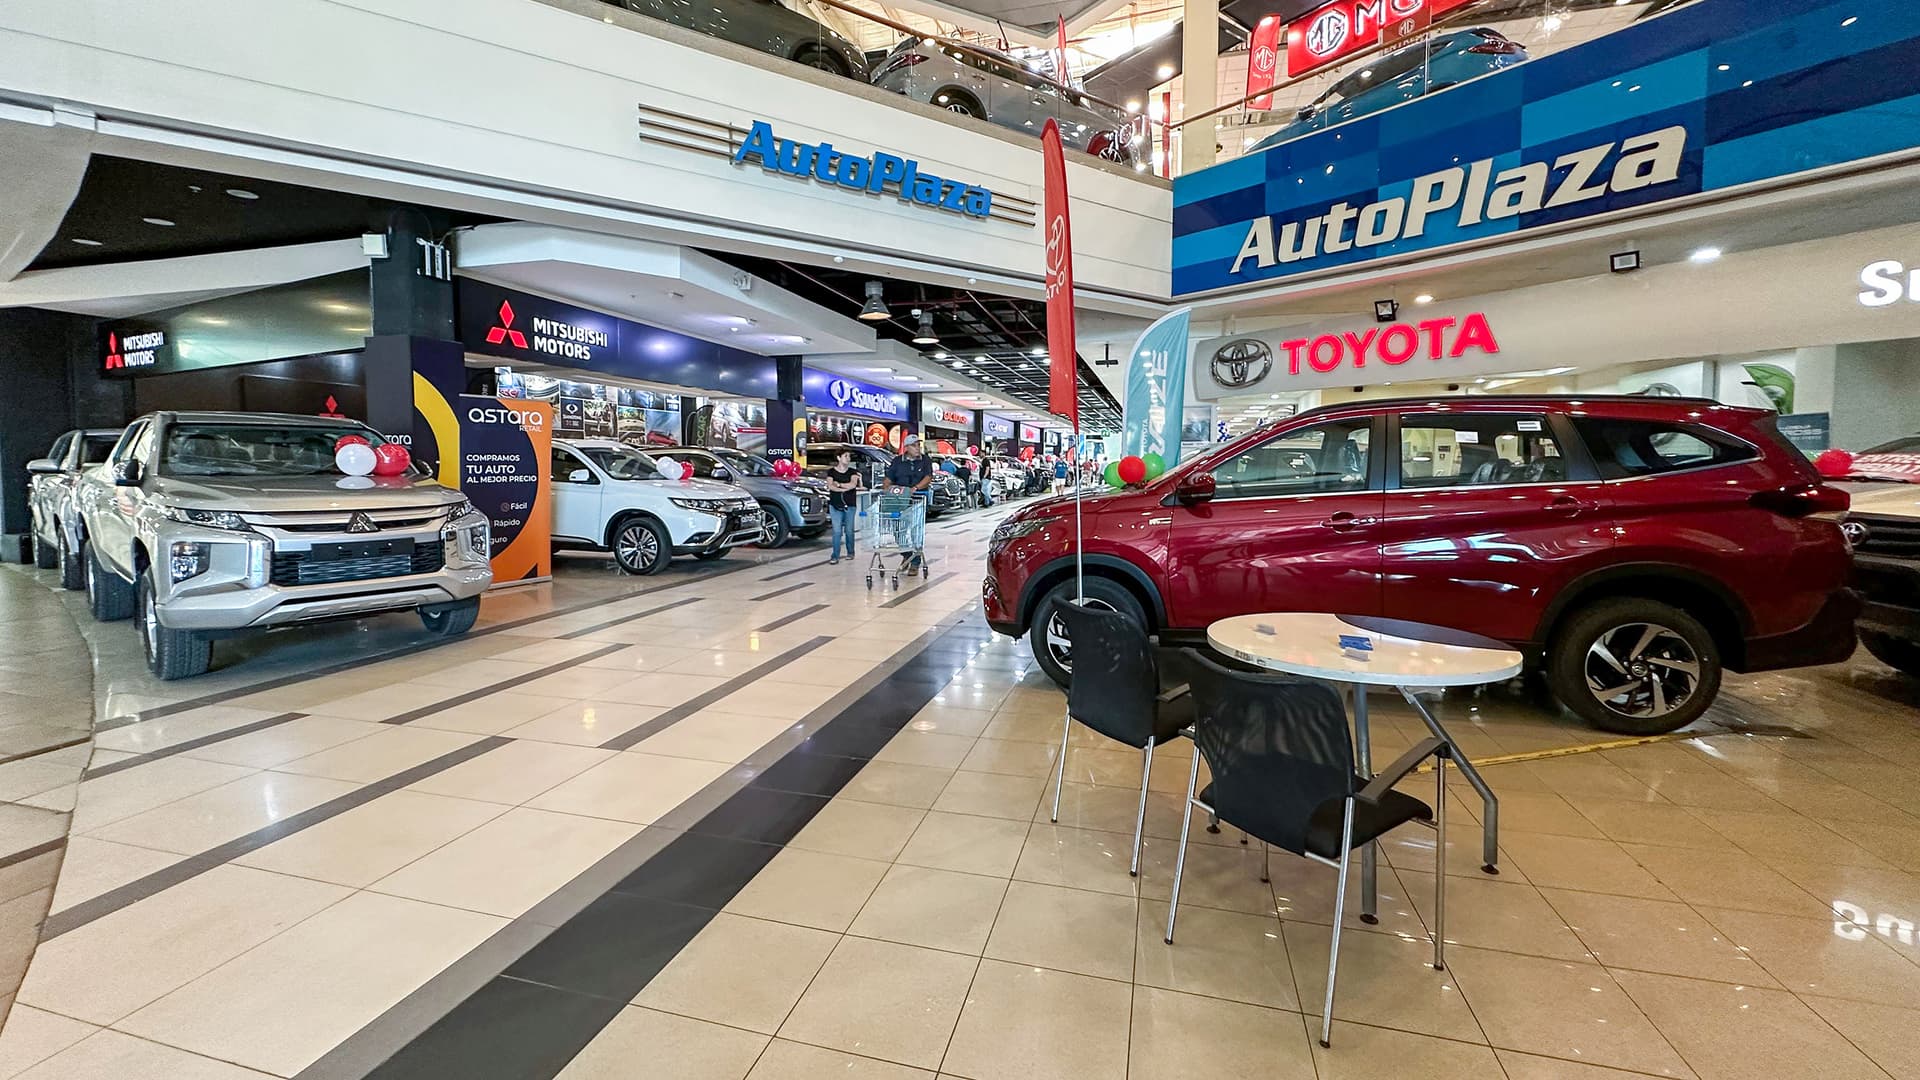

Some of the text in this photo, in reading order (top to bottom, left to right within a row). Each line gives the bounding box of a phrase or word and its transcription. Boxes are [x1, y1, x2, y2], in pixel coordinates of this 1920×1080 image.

[735, 120, 992, 217] AutoPlaza
[1229, 125, 1687, 273] AutoPlaza
[123, 331, 164, 351] MITSUBISHI
[533, 317, 608, 347] MITSUBISHI
[534, 335, 591, 360] MOTORS
[1280, 312, 1500, 375] TOYOTA
[124, 350, 155, 367] MOTORS
[466, 454, 520, 462] COMPRAMOS
[466, 465, 516, 474] TU AUTO
[466, 476, 478, 484] AL
[509, 475, 537, 483] PRECIO
[510, 502, 528, 510] Fácil
[494, 518, 521, 528] Rápido
